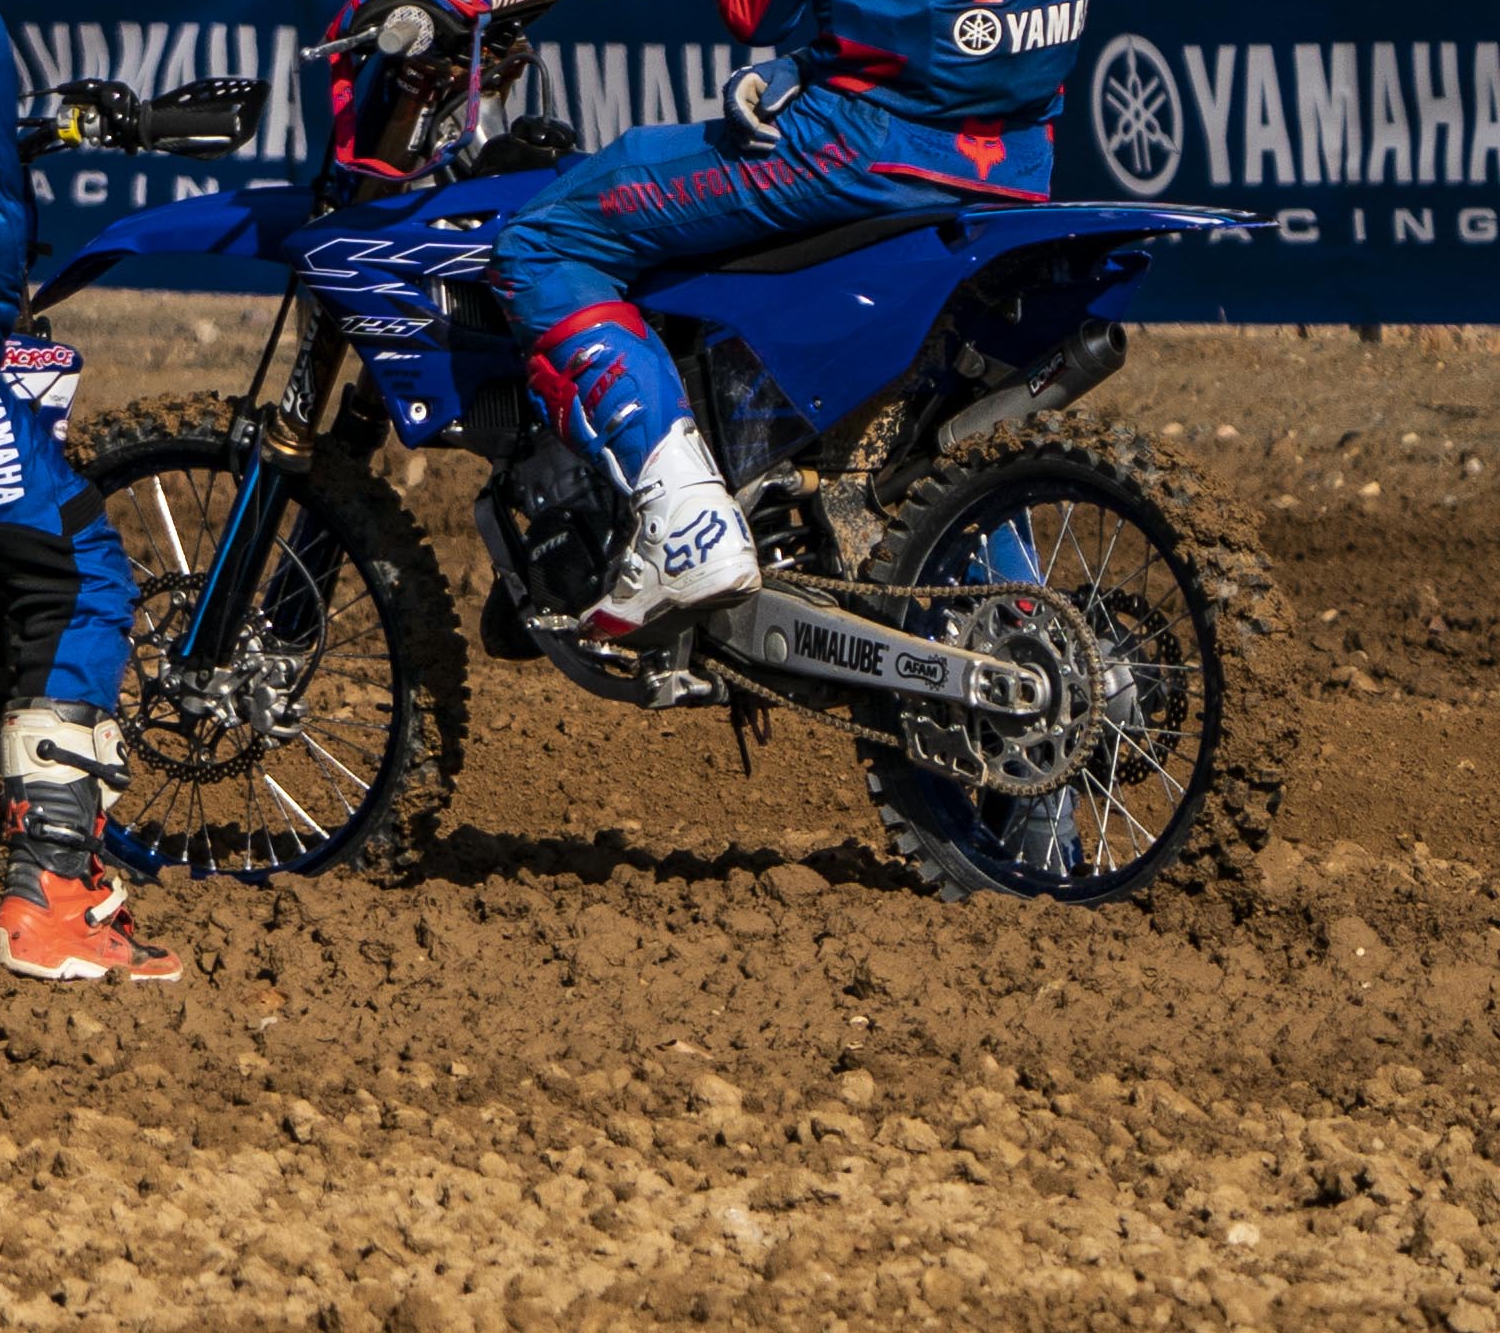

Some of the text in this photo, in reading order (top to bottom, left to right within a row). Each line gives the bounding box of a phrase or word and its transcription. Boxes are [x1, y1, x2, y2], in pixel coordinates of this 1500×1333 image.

[598, 177, 693, 217] MOTO-X
[0, 346, 75, 371] ACROCE
[793, 619, 886, 676] YAMALUBE
[903, 656, 940, 680] AFAM
